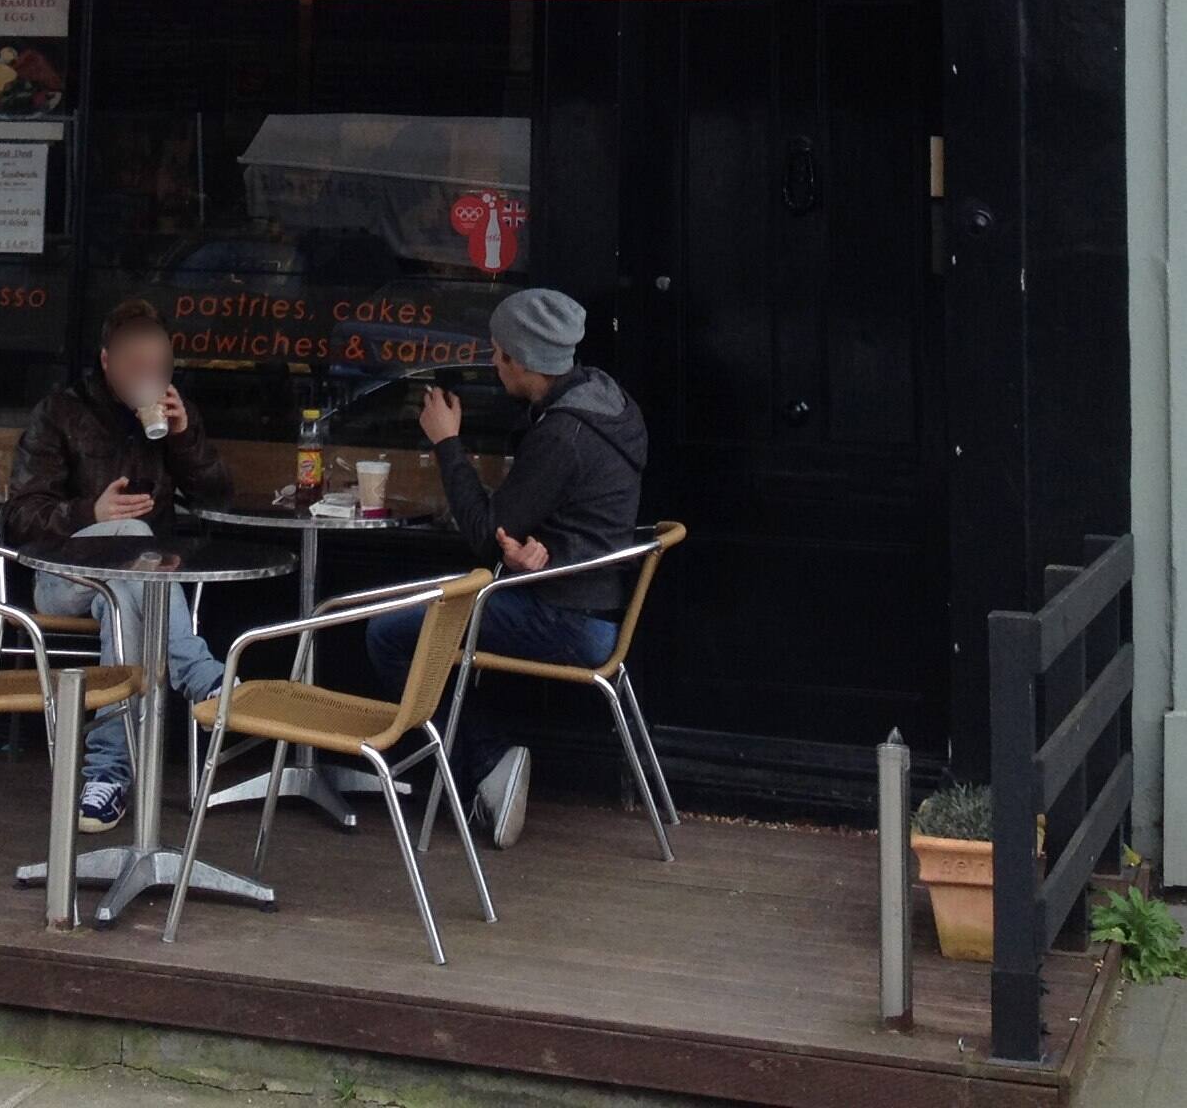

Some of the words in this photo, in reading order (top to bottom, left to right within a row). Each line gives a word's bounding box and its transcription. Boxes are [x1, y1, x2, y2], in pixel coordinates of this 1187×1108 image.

[175, 293, 315, 321] pastries,
[333, 298, 433, 325] cakes
[344, 334, 365, 360] &
